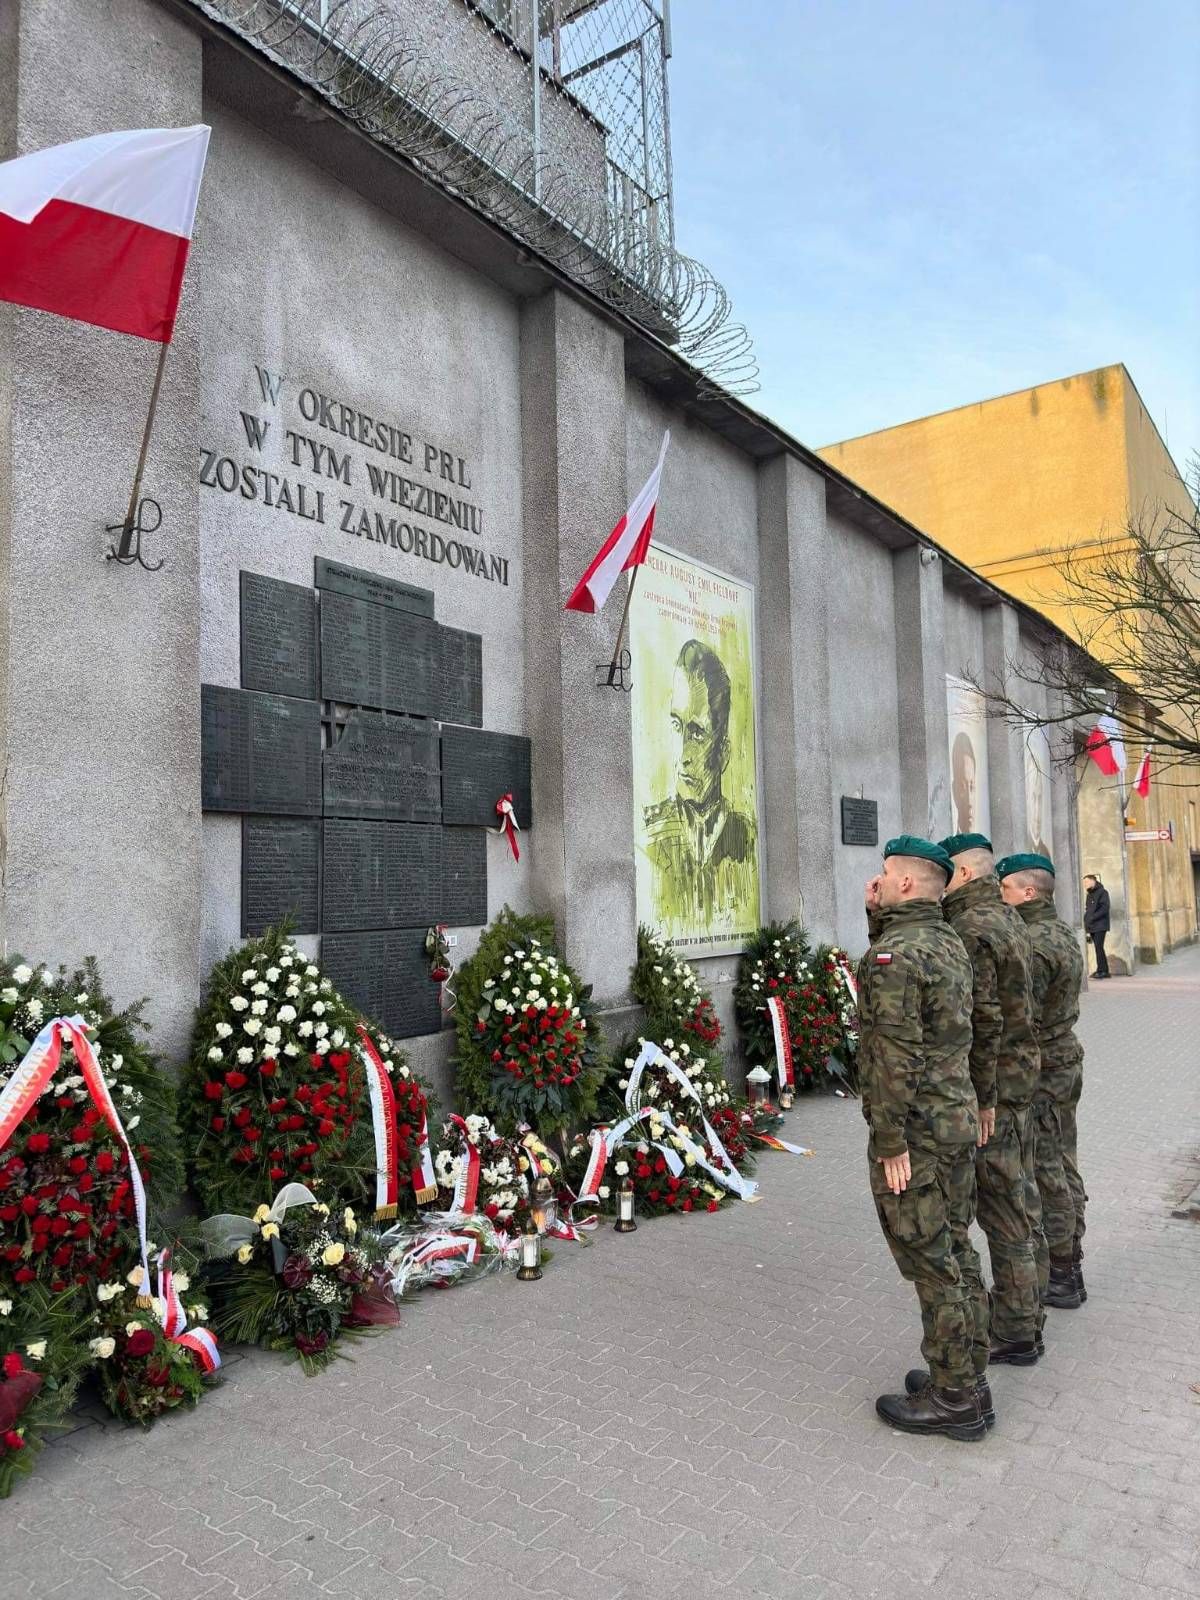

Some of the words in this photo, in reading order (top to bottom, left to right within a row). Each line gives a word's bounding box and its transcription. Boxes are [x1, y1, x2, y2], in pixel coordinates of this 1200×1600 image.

[240, 411, 271, 452] W
[286, 430, 352, 486] TYM
[255, 365, 286, 407] W
[299, 388, 413, 465] OKRESIE
[424, 443, 471, 489] PRL
[199, 447, 325, 524] ZOSTALI
[340, 499, 509, 586] ZAMORDOWANI
